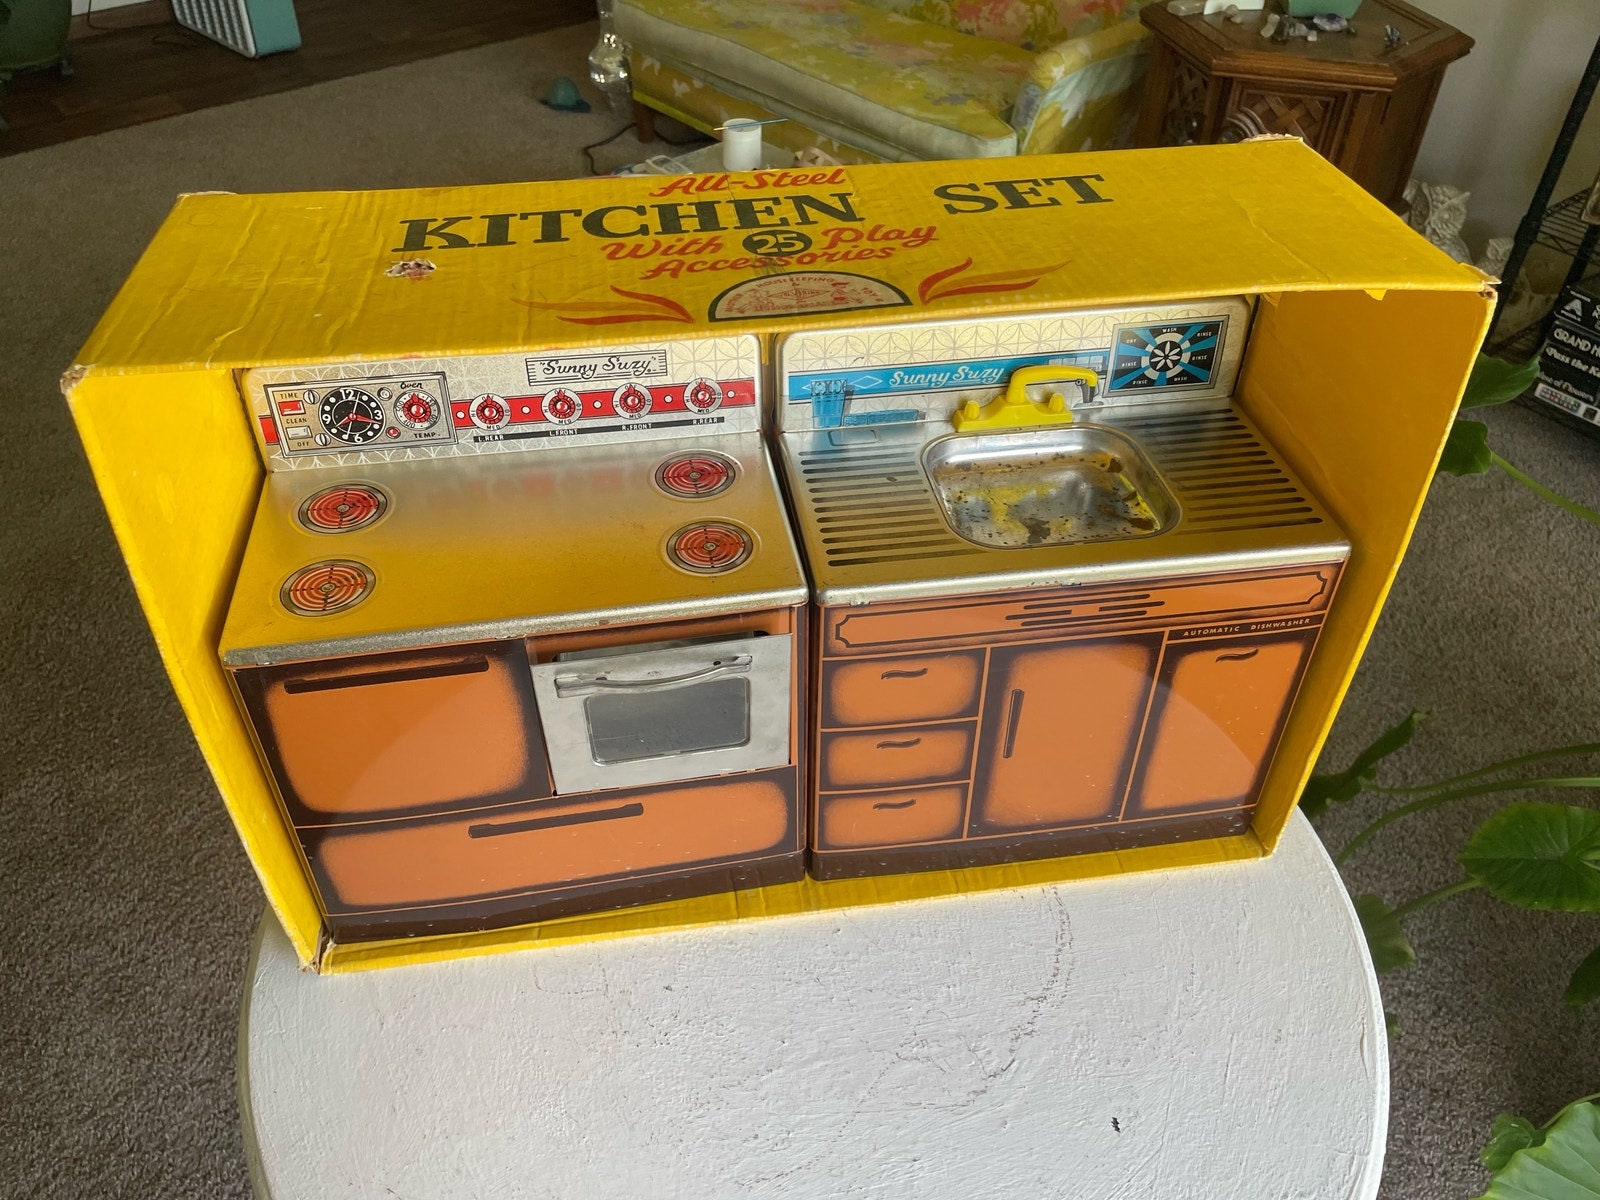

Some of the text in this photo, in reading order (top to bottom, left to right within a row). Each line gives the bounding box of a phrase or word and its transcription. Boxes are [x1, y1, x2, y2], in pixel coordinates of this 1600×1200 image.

[648, 168, 847, 197] All-Steel
[391, 174, 1114, 253] KITCHEN SET
[601, 224, 938, 261] With 25 Play
[639, 245, 896, 280] Accessories
[756, 276, 835, 289] HOUSEKEEPING
[1553, 328, 1591, 352] GRAND
[1545, 346, 1571, 364] Pass
[1571, 358, 1589, 372] the
[400, 381, 424, 390] Oven
[889, 365, 1005, 388] Sunny Suzy
[339, 388, 356, 400] 12
[322, 413, 331, 425] 9
[374, 409, 383, 420] 3
[354, 434, 363, 444] 6
[1183, 618, 1311, 637] AUTOMATIC DISHWASHER
